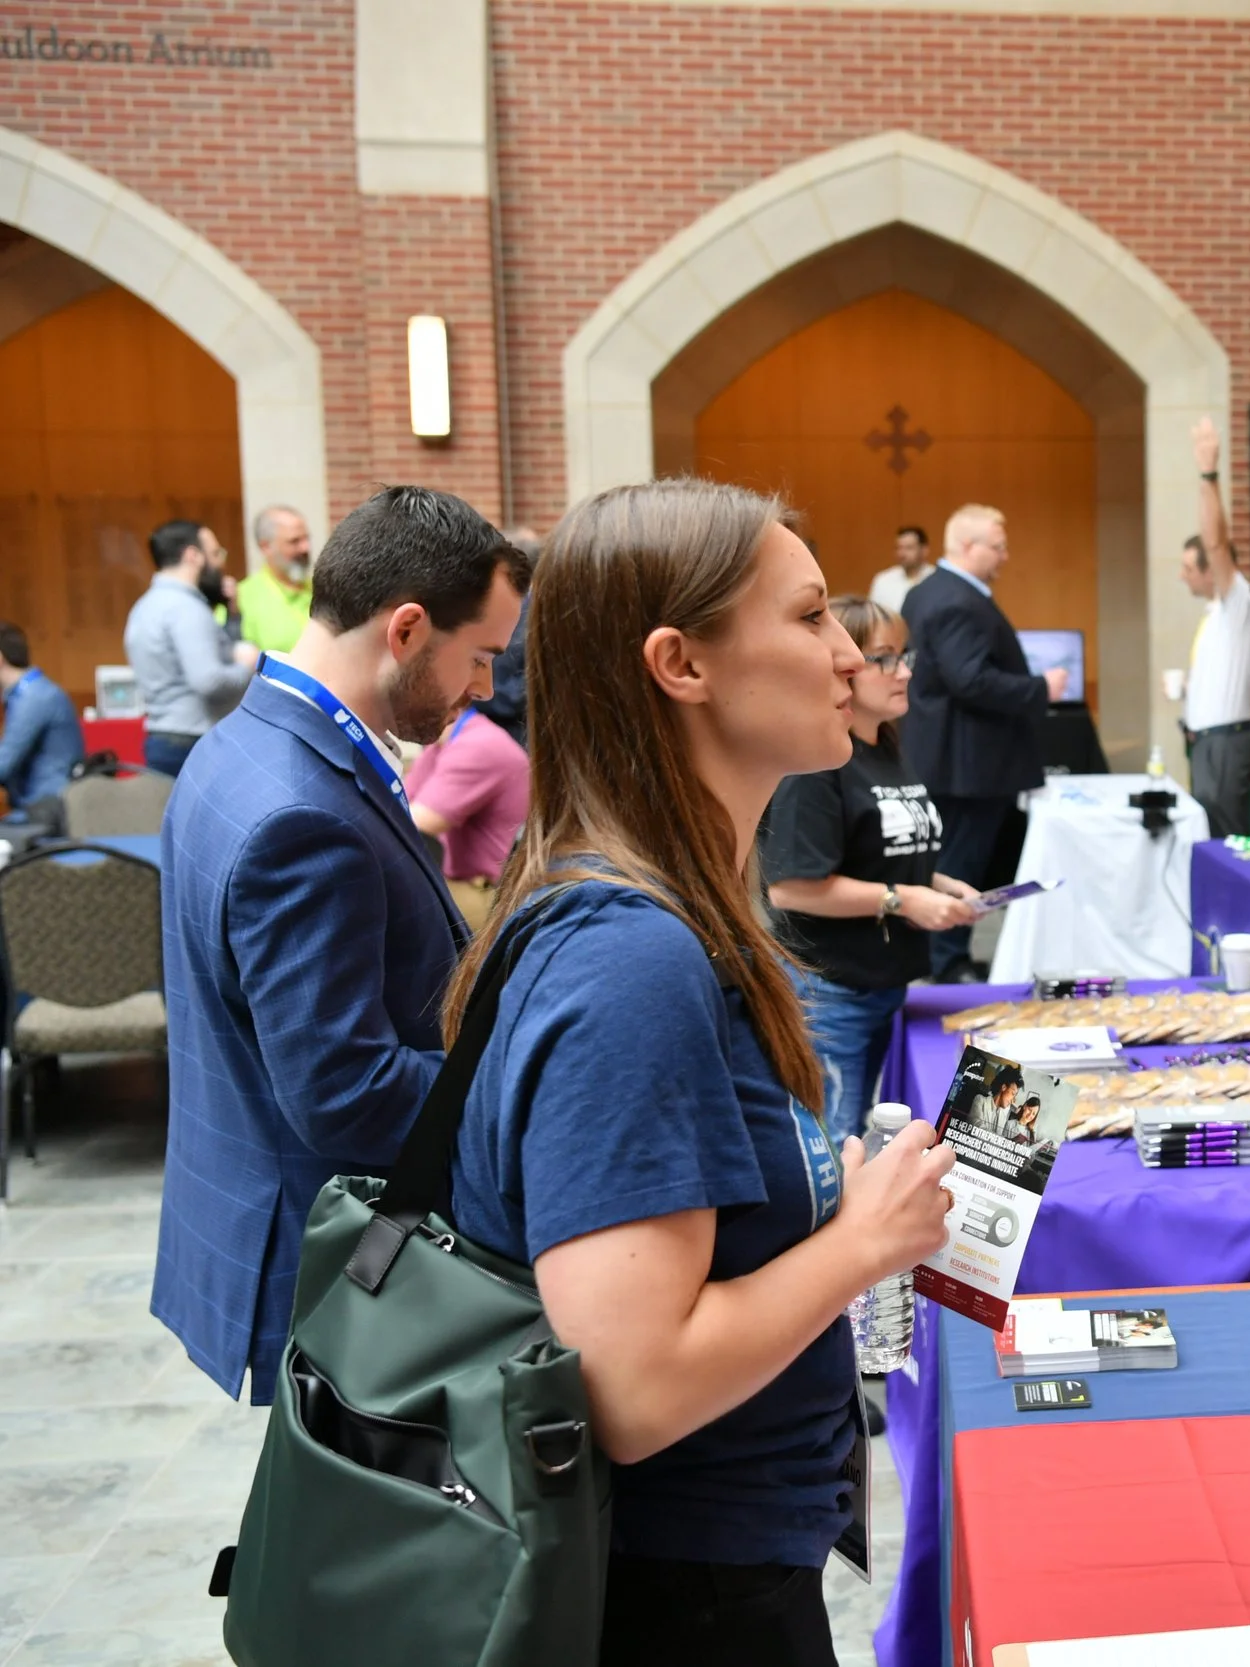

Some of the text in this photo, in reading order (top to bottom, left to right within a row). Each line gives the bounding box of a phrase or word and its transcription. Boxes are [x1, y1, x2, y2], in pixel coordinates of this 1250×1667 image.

[146, 32, 273, 69] Atrium
[349, 721, 365, 740] TECH
[944, 1128, 1026, 1167] RESEARCHERS COMMERCIALIZE
[949, 1117, 960, 1129] WE
[958, 1120, 973, 1133] HELP
[971, 1126, 1016, 1152] ENTREPRENEURS
[808, 1136, 837, 1217] THE
[952, 1143, 992, 1166] CORPORATIONS
[990, 1159, 1019, 1178] INNOVATE.
[958, 1172, 987, 1190] COMBINATION
[986, 1183, 997, 1193] FOR
[995, 1187, 1017, 1201] SUPPORT
[949, 1257, 973, 1273] RESEARCH
[970, 1266, 1000, 1285] INSTITUTIONS
